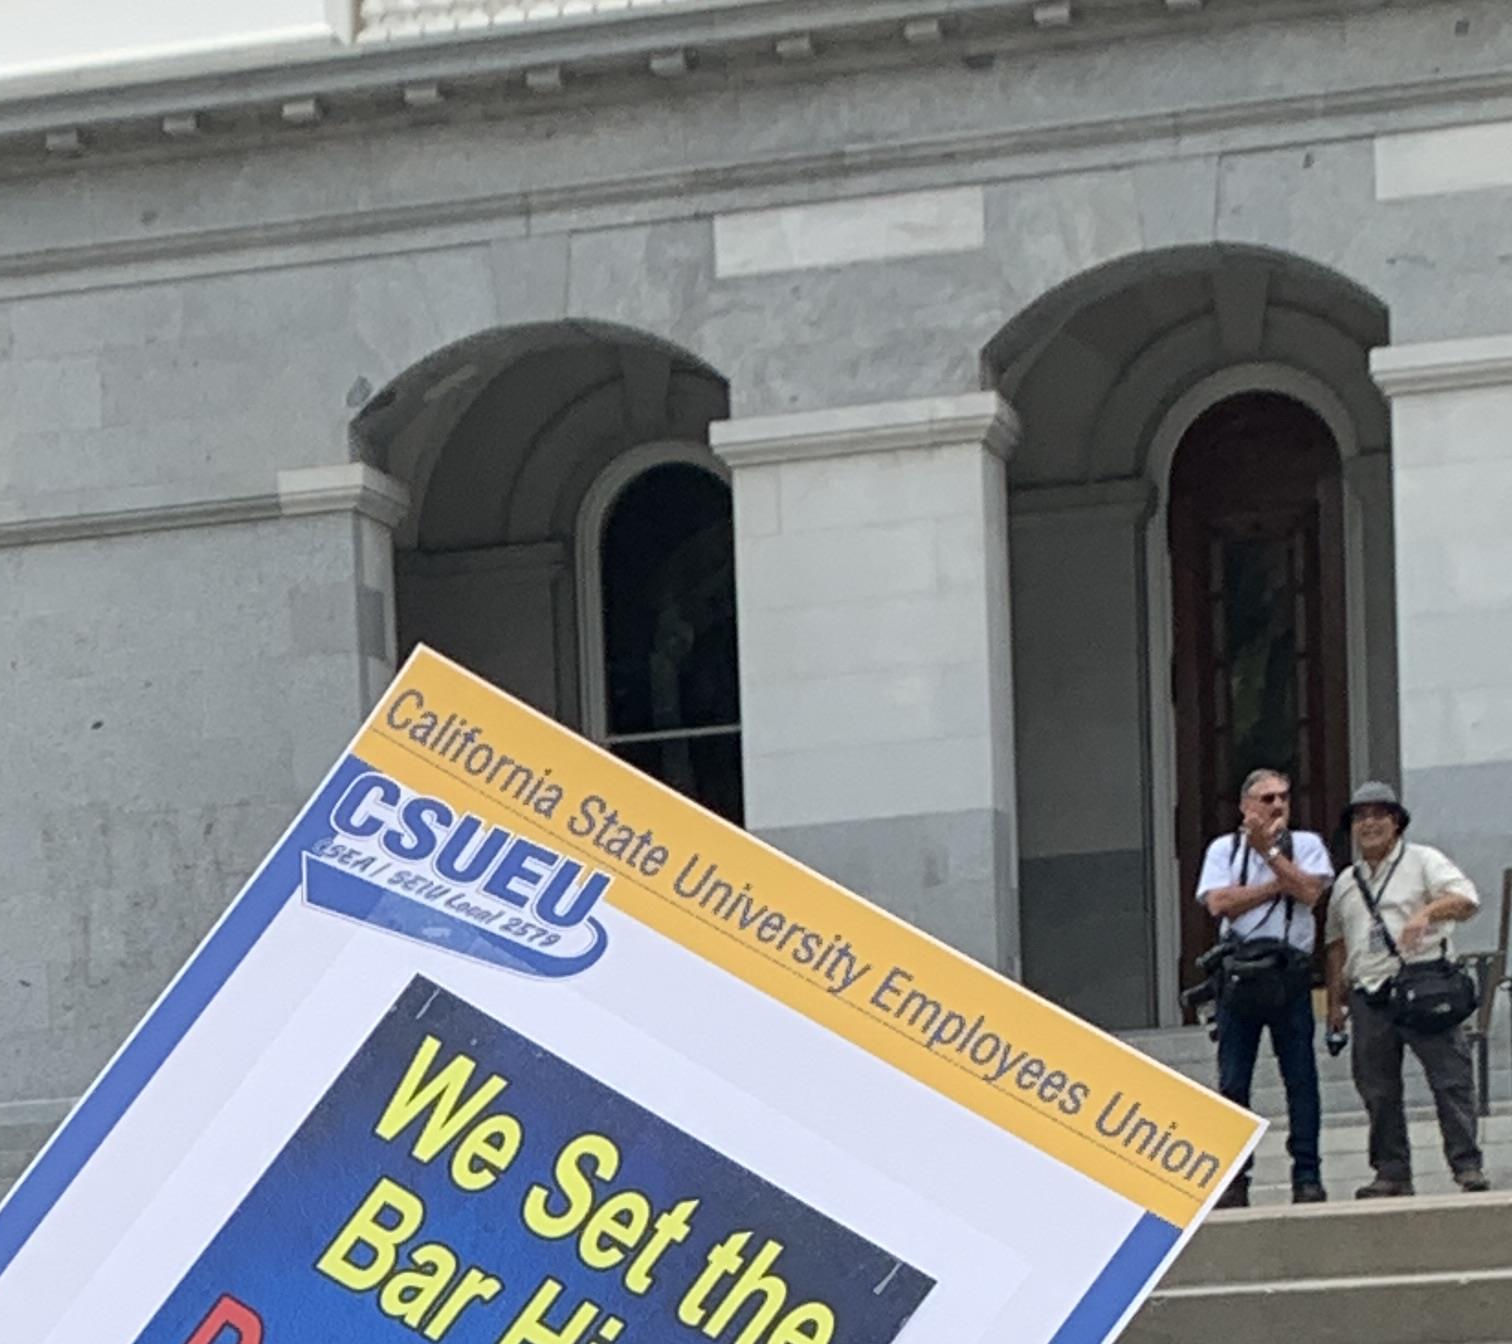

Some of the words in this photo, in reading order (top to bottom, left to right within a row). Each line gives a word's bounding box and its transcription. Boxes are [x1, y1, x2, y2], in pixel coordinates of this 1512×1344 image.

[331, 771, 612, 928] CSUEU
[388, 869, 451, 900] SEIU
[444, 893, 500, 925] Local
[499, 917, 562, 947] 2579
[384, 686, 564, 819] California
[567, 793, 670, 880] State
[673, 848, 869, 995] University
[870, 967, 1090, 1117] Employees
[1094, 1091, 1222, 1190] Union
[372, 1034, 524, 1192] We
[521, 1131, 698, 1296] Set
[315, 1175, 502, 1343] Bar
